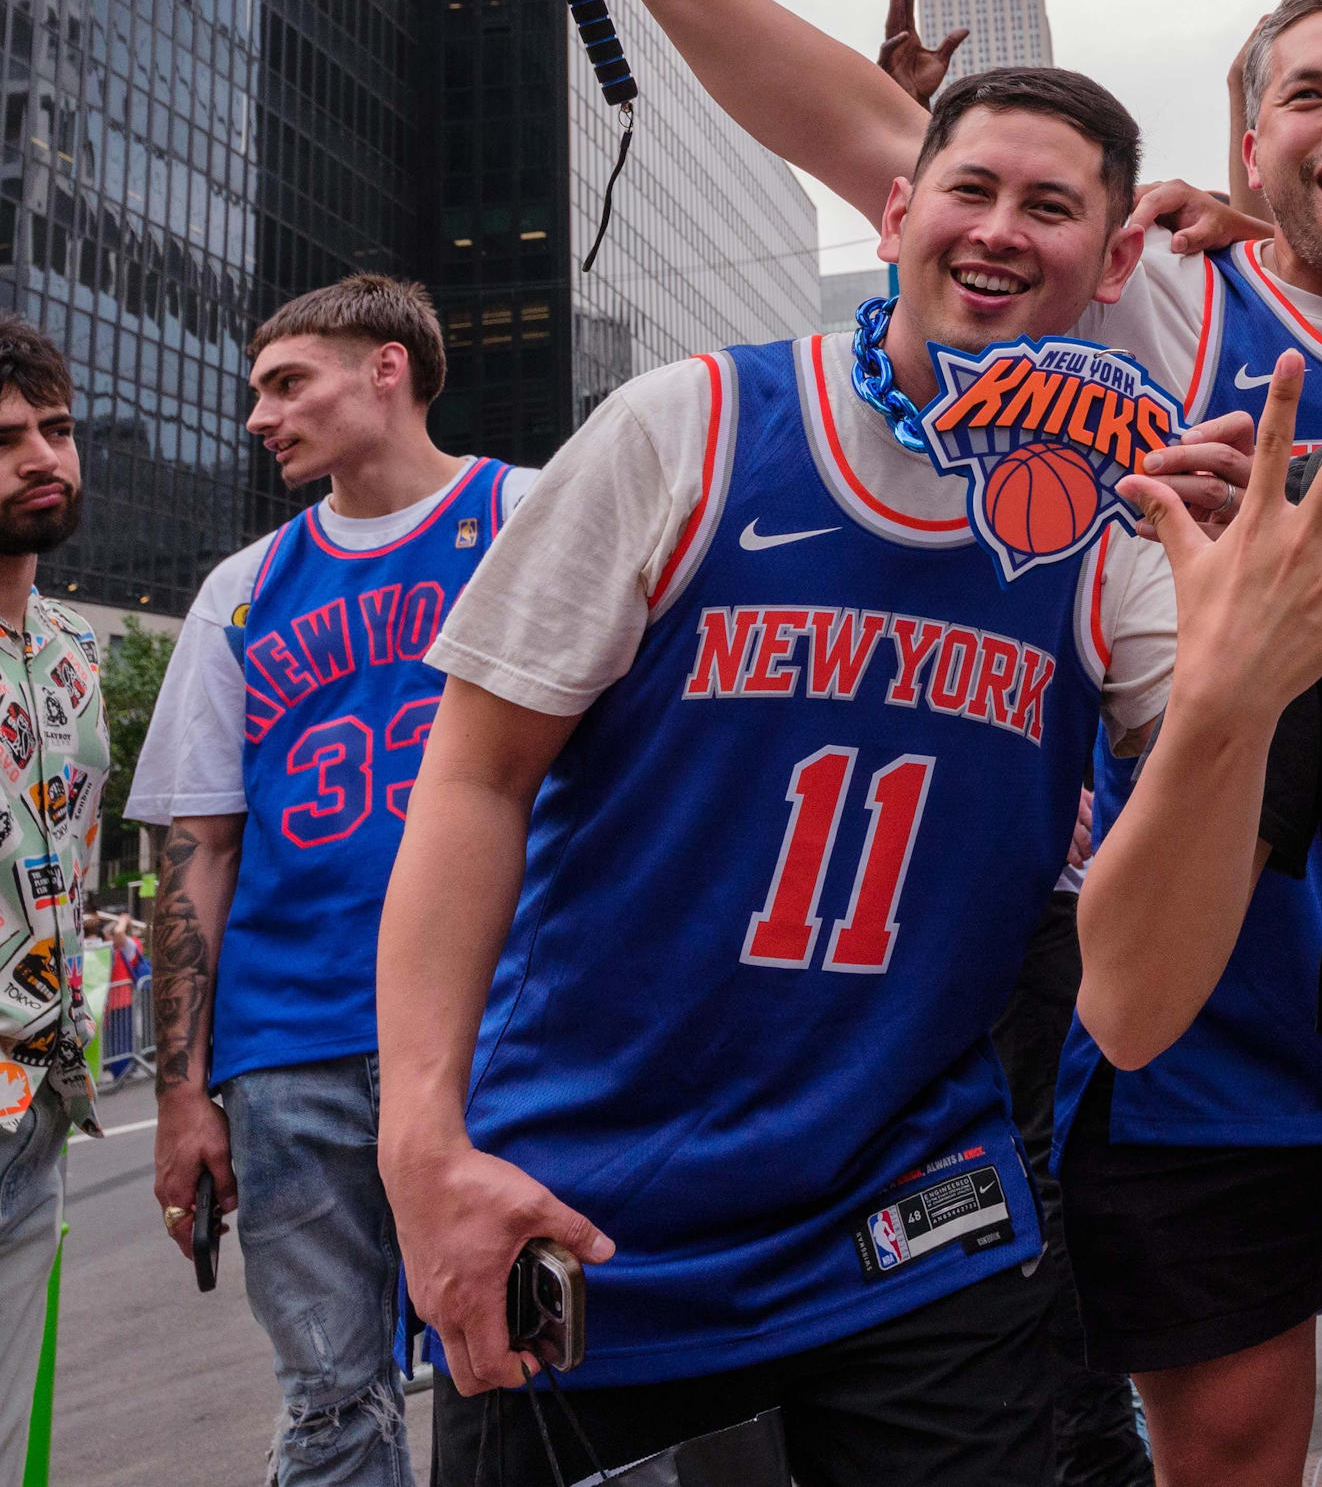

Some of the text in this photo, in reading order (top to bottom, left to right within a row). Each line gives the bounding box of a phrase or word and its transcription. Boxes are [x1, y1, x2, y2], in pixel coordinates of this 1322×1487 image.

[1039, 350, 1136, 397] NEW YORK
[935, 358, 1171, 474] KNICKS
[681, 604, 1057, 749] NEW YORK
[738, 743, 937, 975] 11
[926, 1155, 958, 1174] ALWAYS
[957, 1152, 965, 1163] A
[923, 1178, 970, 1200] ENGINEERED
[908, 1210, 921, 1224] 48
